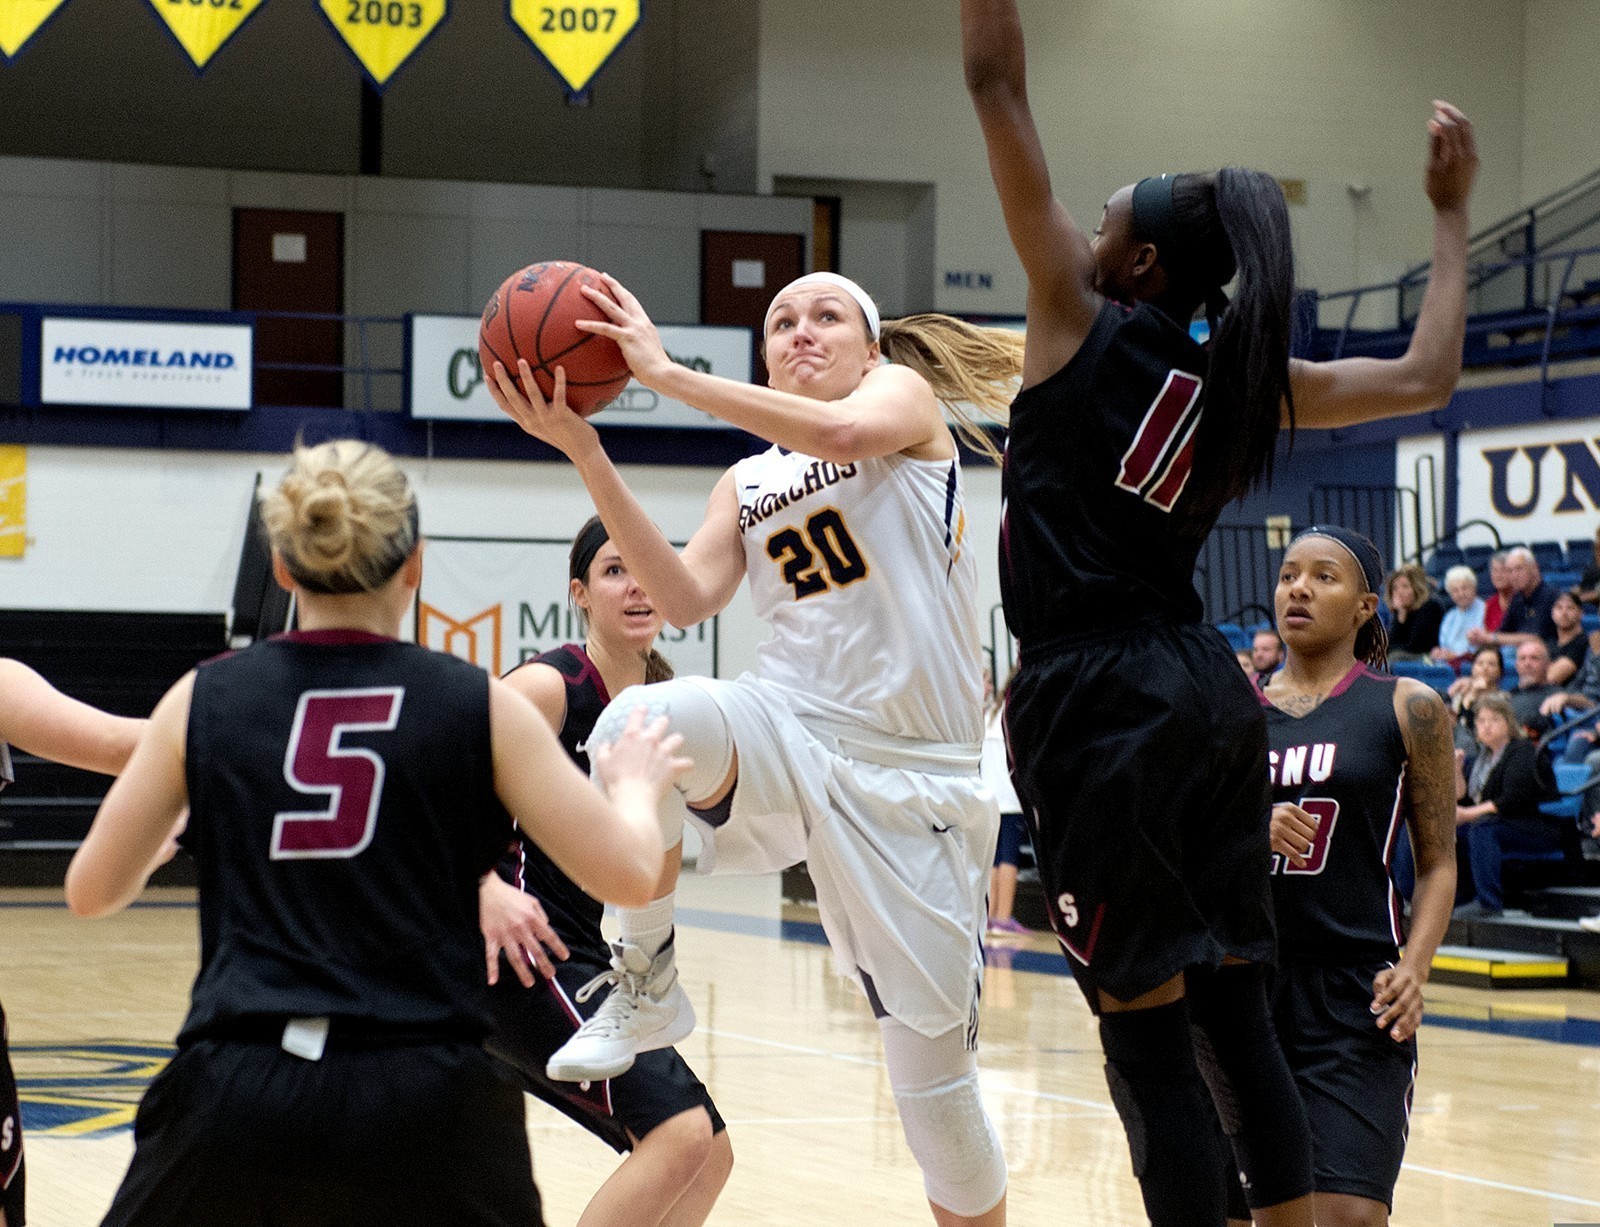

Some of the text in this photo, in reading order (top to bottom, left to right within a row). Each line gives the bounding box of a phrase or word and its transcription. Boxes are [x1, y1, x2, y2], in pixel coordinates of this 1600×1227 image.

[346, 0, 423, 28] 2003
[541, 8, 617, 32] 2007
[945, 272, 992, 288] MEN
[53, 346, 235, 369] HOMELAND
[765, 505, 871, 602] 20
[269, 686, 405, 861] 5
[1058, 892, 1079, 928] S
[1, 1115, 14, 1151] S
